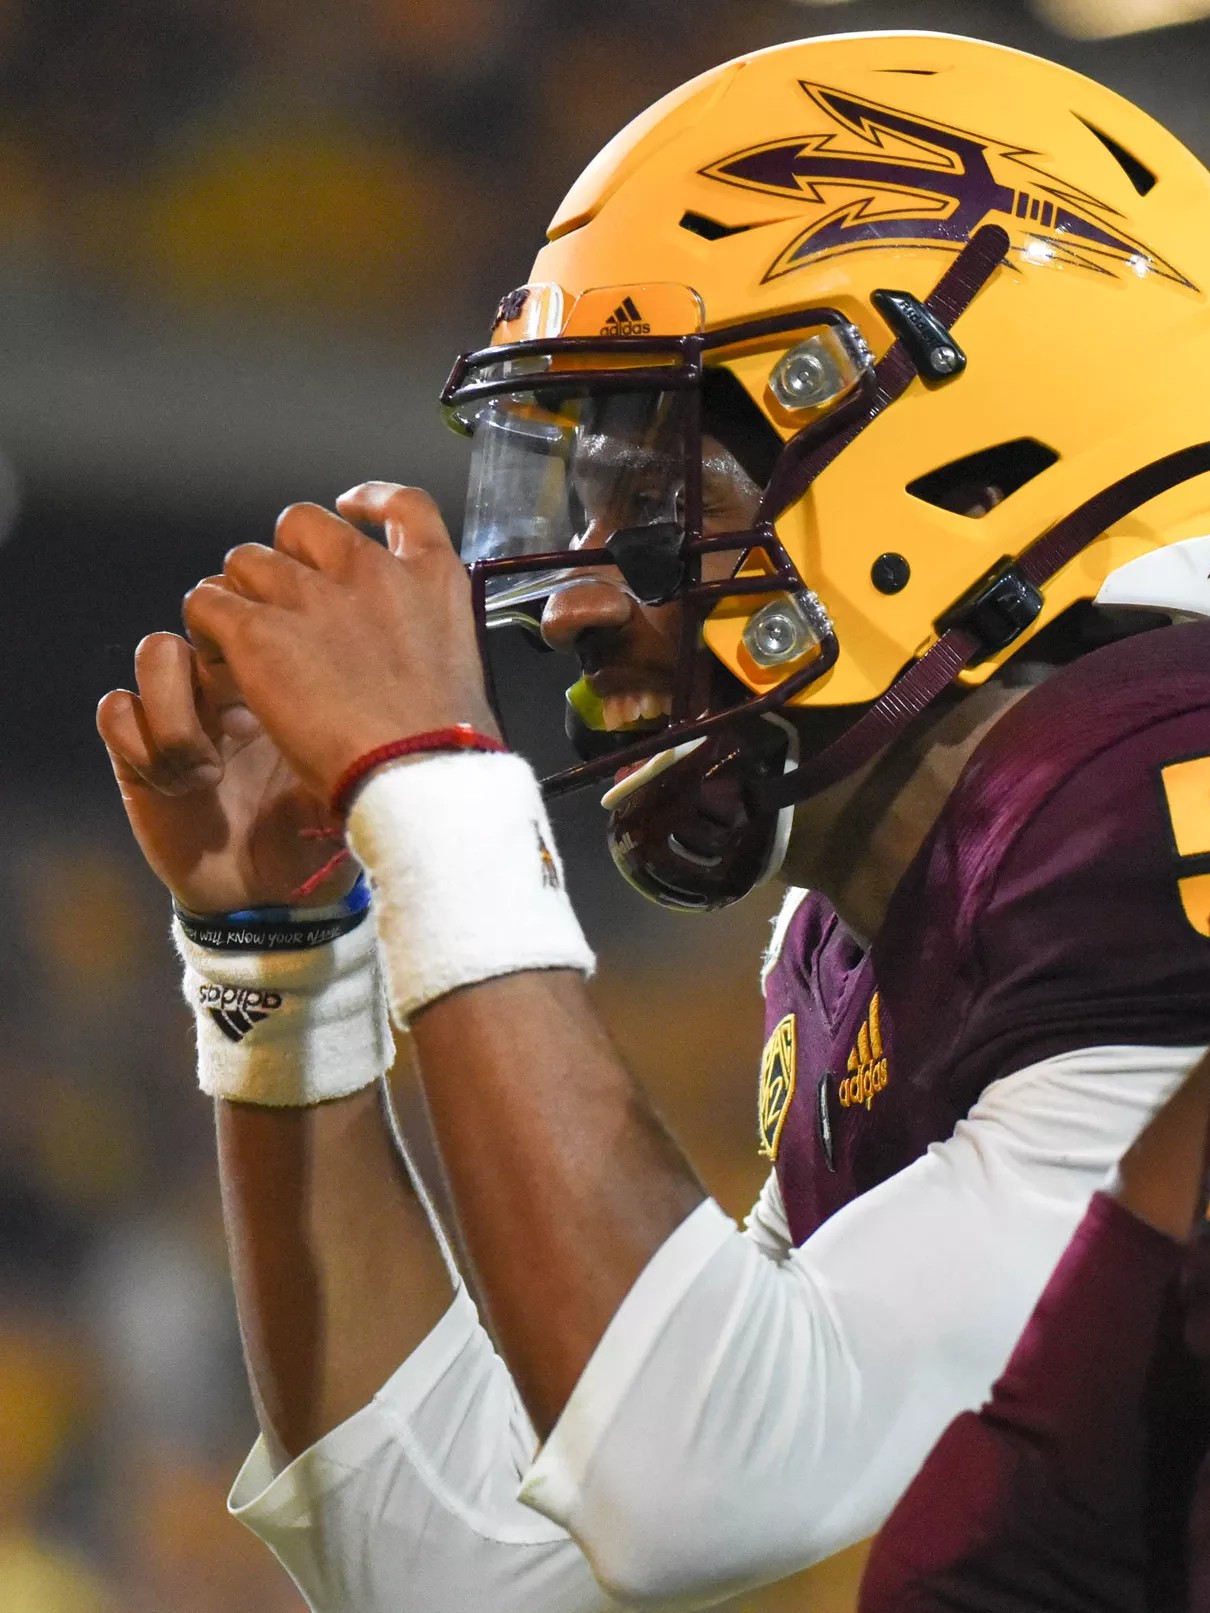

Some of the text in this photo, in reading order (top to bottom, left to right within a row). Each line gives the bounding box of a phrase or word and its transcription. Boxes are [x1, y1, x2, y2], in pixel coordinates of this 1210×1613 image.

[600, 320, 650, 337] adidas
[199, 929, 226, 946] WILL
[226, 929, 265, 945] KNOW
[267, 930, 304, 948] YOUR
[199, 984, 283, 1012] adidas
[838, 1057, 889, 1108] adidas
